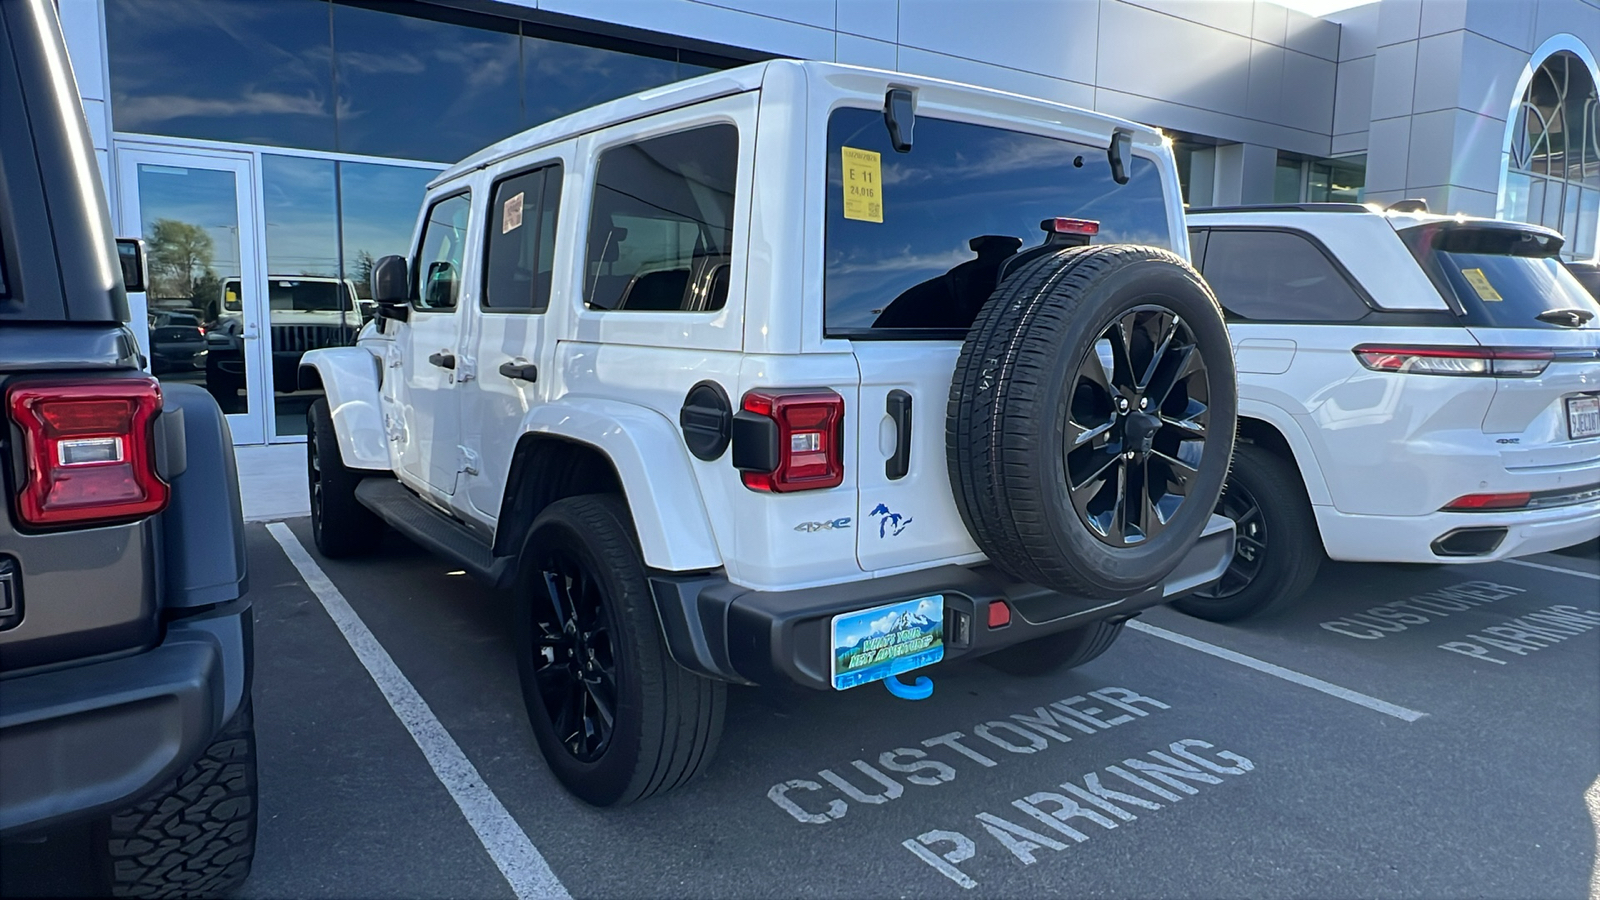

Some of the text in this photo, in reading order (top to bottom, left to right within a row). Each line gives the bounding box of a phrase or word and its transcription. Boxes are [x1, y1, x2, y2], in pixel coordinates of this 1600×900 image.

[849, 169, 872, 183] E 11
[850, 186, 874, 197] 24,016
[1319, 580, 1527, 639] CUSTOMER
[848, 634, 933, 669] NEXT ADVENTURE?
[863, 626, 922, 652] WHAT'S YOUR
[767, 686, 1171, 824] CUSTOMER
[902, 738, 1256, 890] PARKING
